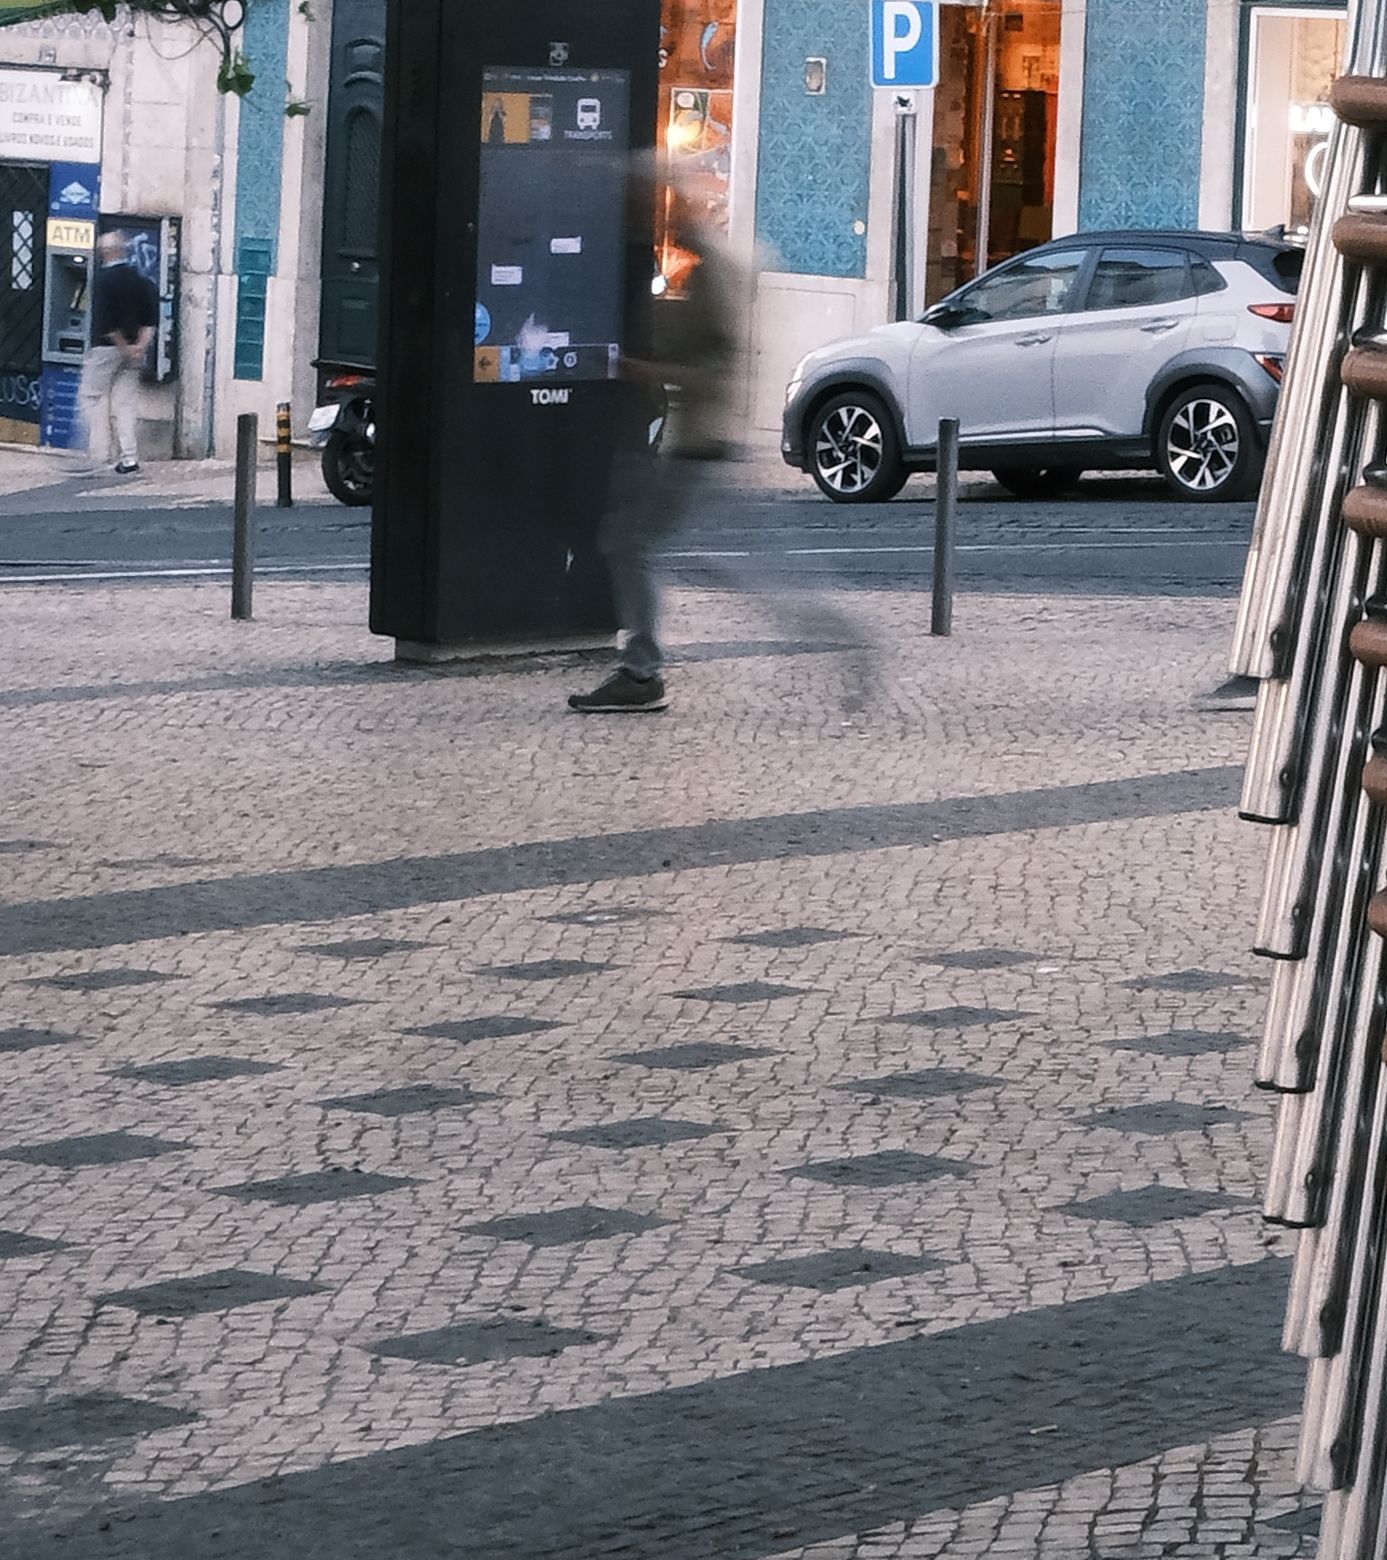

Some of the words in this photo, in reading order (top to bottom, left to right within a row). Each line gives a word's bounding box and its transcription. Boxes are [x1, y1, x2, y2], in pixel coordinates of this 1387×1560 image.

[883, 1, 923, 80] P
[51, 225, 91, 245] ATM
[530, 388, 569, 405] TOMI
